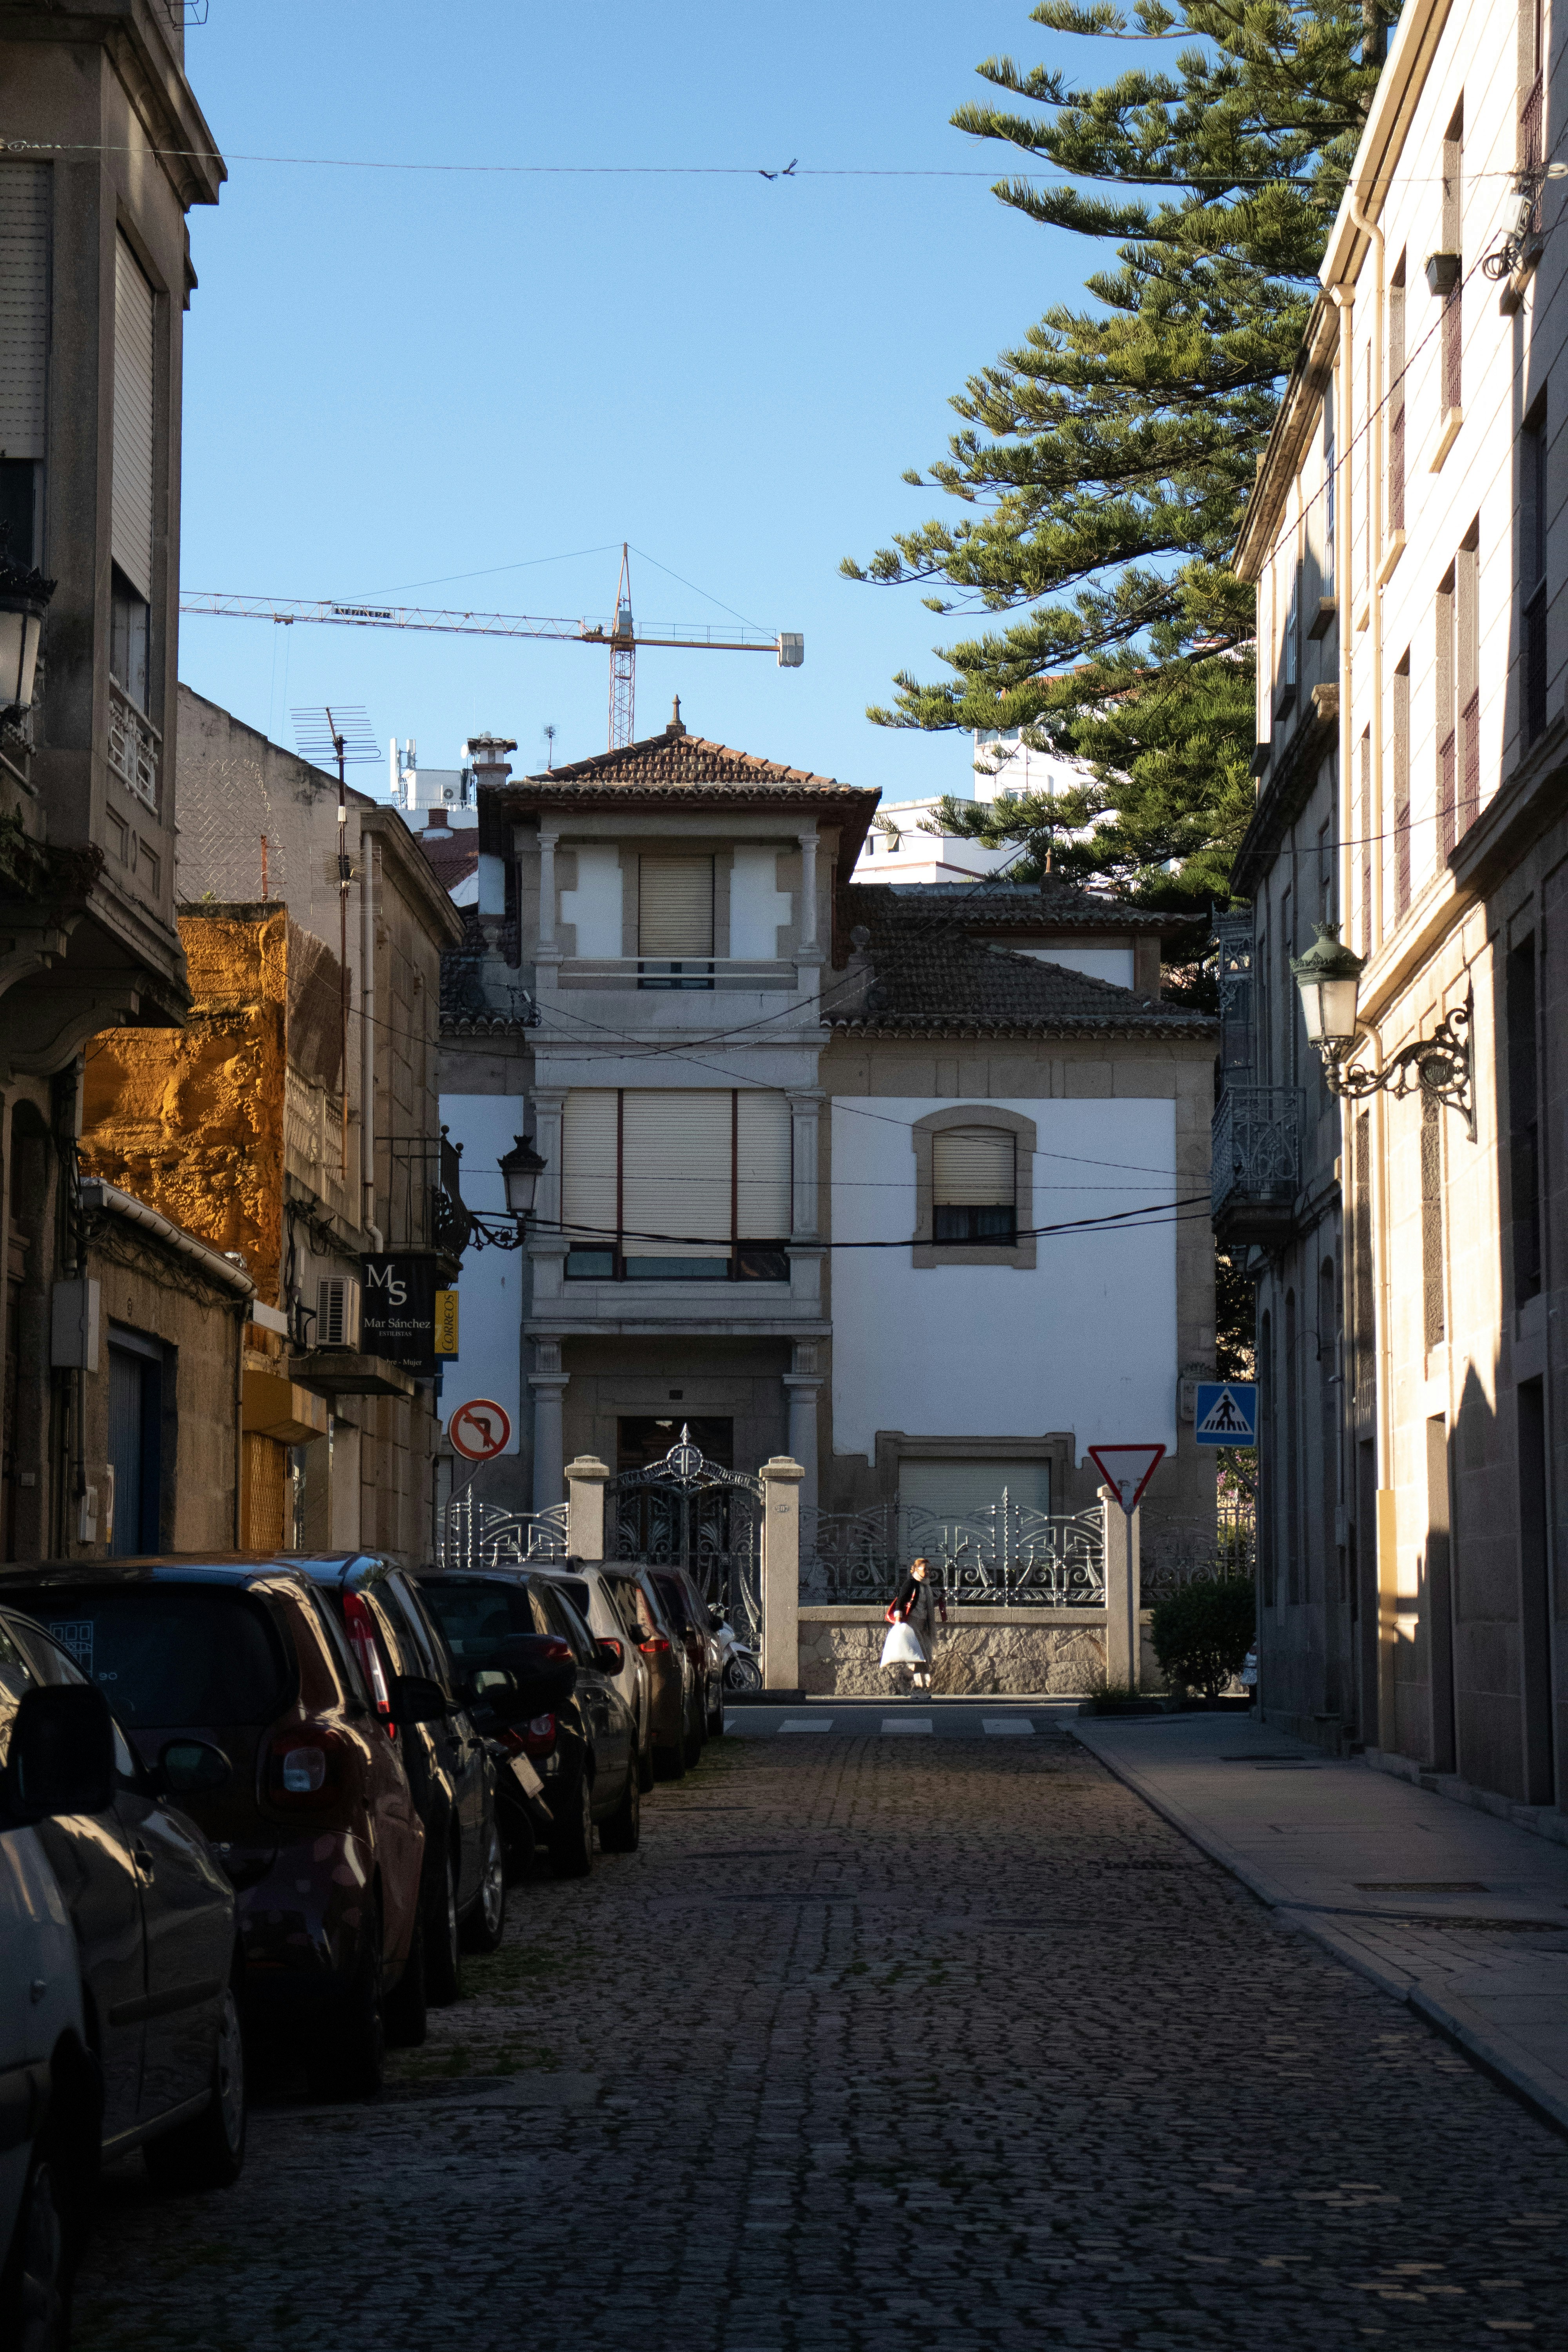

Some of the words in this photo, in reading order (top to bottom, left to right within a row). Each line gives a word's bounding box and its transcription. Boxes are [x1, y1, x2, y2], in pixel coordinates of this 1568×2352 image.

[364, 1318, 385, 1328] Mar
[388, 1318, 431, 1328] Sánchez
[442, 1294, 454, 1351] CORREOS
[403, 1359, 422, 1367] Mujer
[619, 1472, 641, 1485] VILLA
